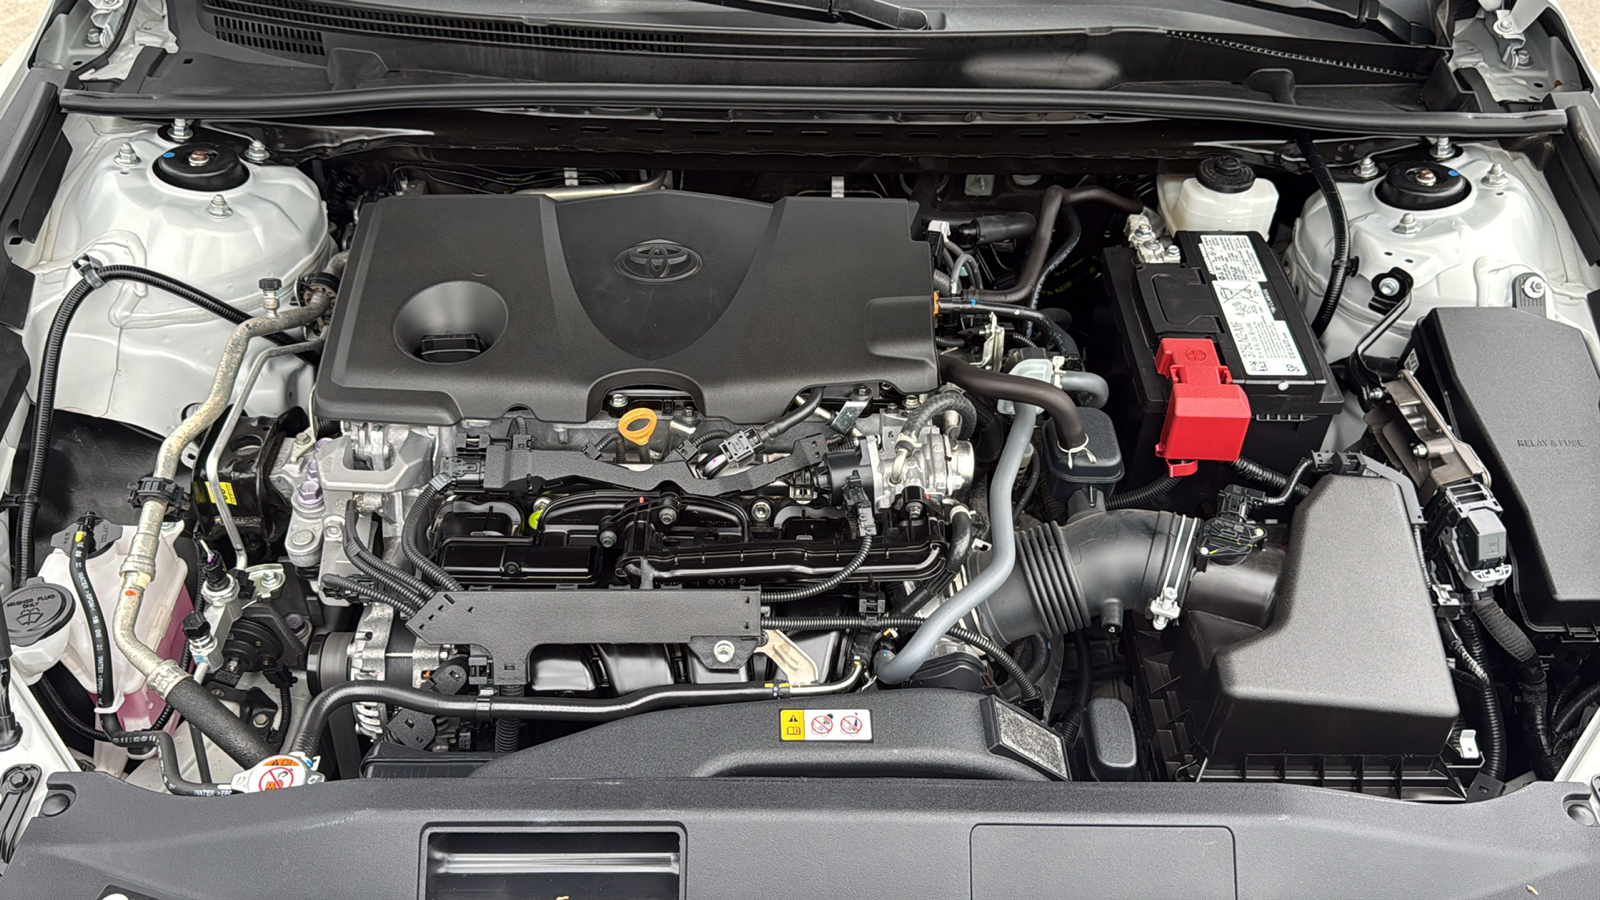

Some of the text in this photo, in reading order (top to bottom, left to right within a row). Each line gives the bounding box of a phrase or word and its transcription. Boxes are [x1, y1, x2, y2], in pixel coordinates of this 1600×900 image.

[1517, 439, 1585, 447] RELAY & FUSE
[194, 789, 215, 797] WATER
